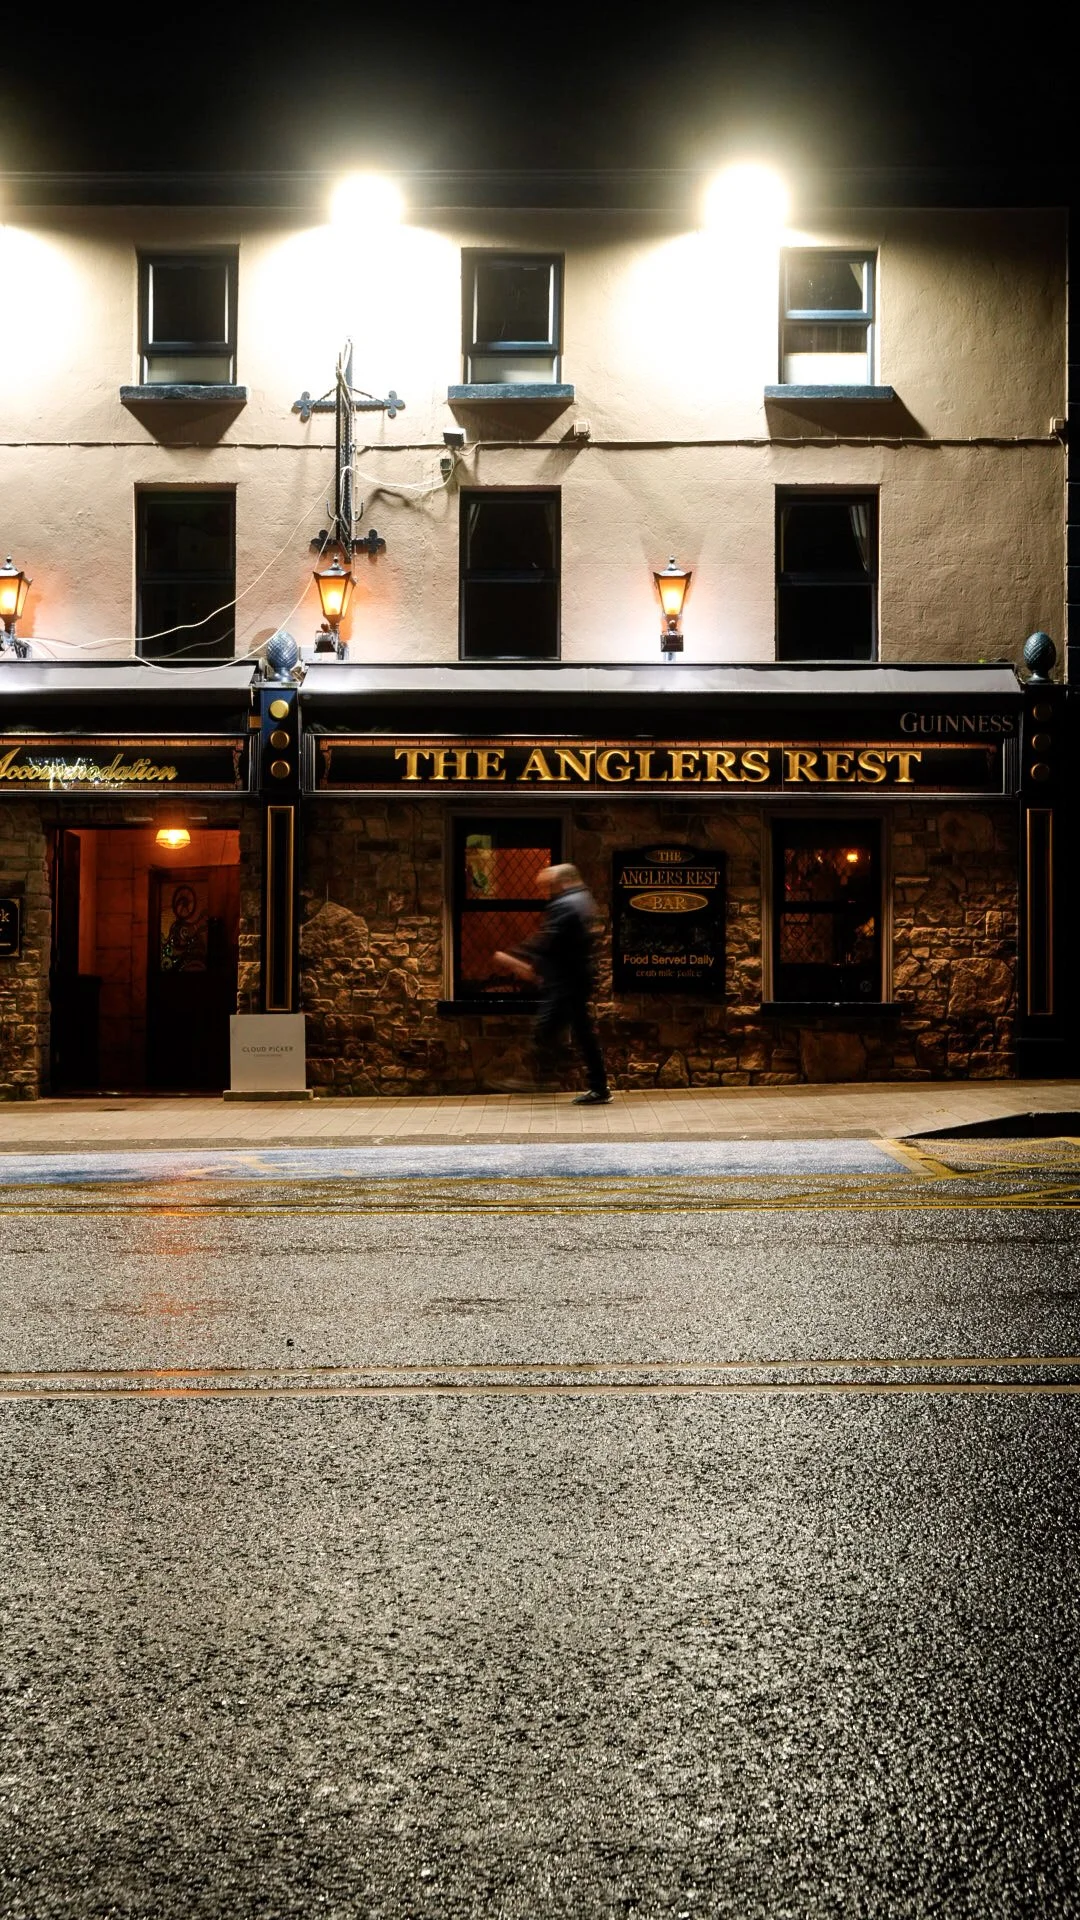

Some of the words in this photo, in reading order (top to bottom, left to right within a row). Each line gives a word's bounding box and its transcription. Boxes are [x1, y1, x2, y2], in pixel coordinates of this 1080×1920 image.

[900, 712, 1013, 733] GUINNESS
[395, 748, 506, 781] THE
[516, 749, 770, 782] ANGLERS
[784, 751, 922, 783] REST
[659, 851, 682, 861] THE
[619, 870, 682, 885] ANGLERS
[686, 871, 720, 885] REST
[652, 896, 687, 910] BAR
[623, 954, 648, 965] Food
[652, 954, 687, 965] Served
[689, 954, 715, 967] Daily
